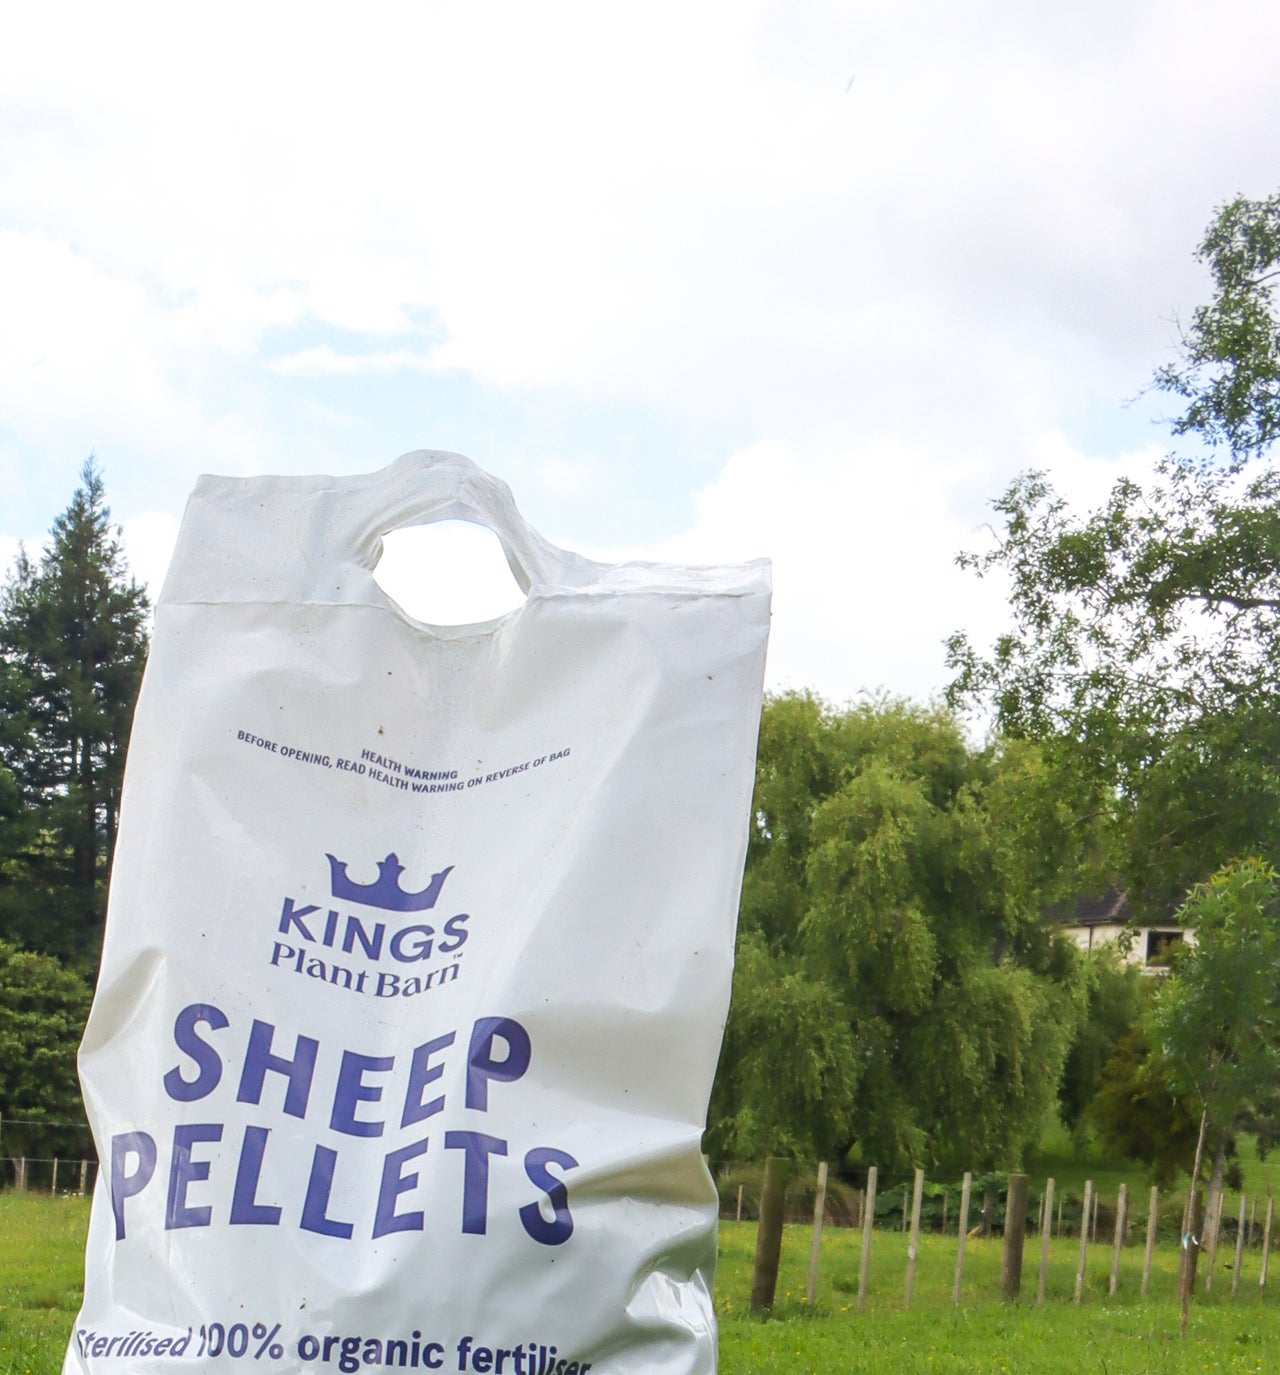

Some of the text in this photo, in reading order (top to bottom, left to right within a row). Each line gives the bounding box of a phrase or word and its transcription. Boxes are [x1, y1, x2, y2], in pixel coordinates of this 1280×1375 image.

[237, 730, 571, 794] BEFORE OPENING, READ HEALTH WARNING ON REVERSE OF BAG
[361, 748, 458, 781] HEALTH WARNING
[278, 897, 470, 964] KINGS
[270, 941, 369, 994] Plant
[373, 962, 461, 998] Barn
[163, 1003, 532, 1138] SHEEP
[111, 1123, 579, 1246] PELLETS
[197, 1323, 284, 1361] 100%
[297, 1330, 444, 1374] organic
